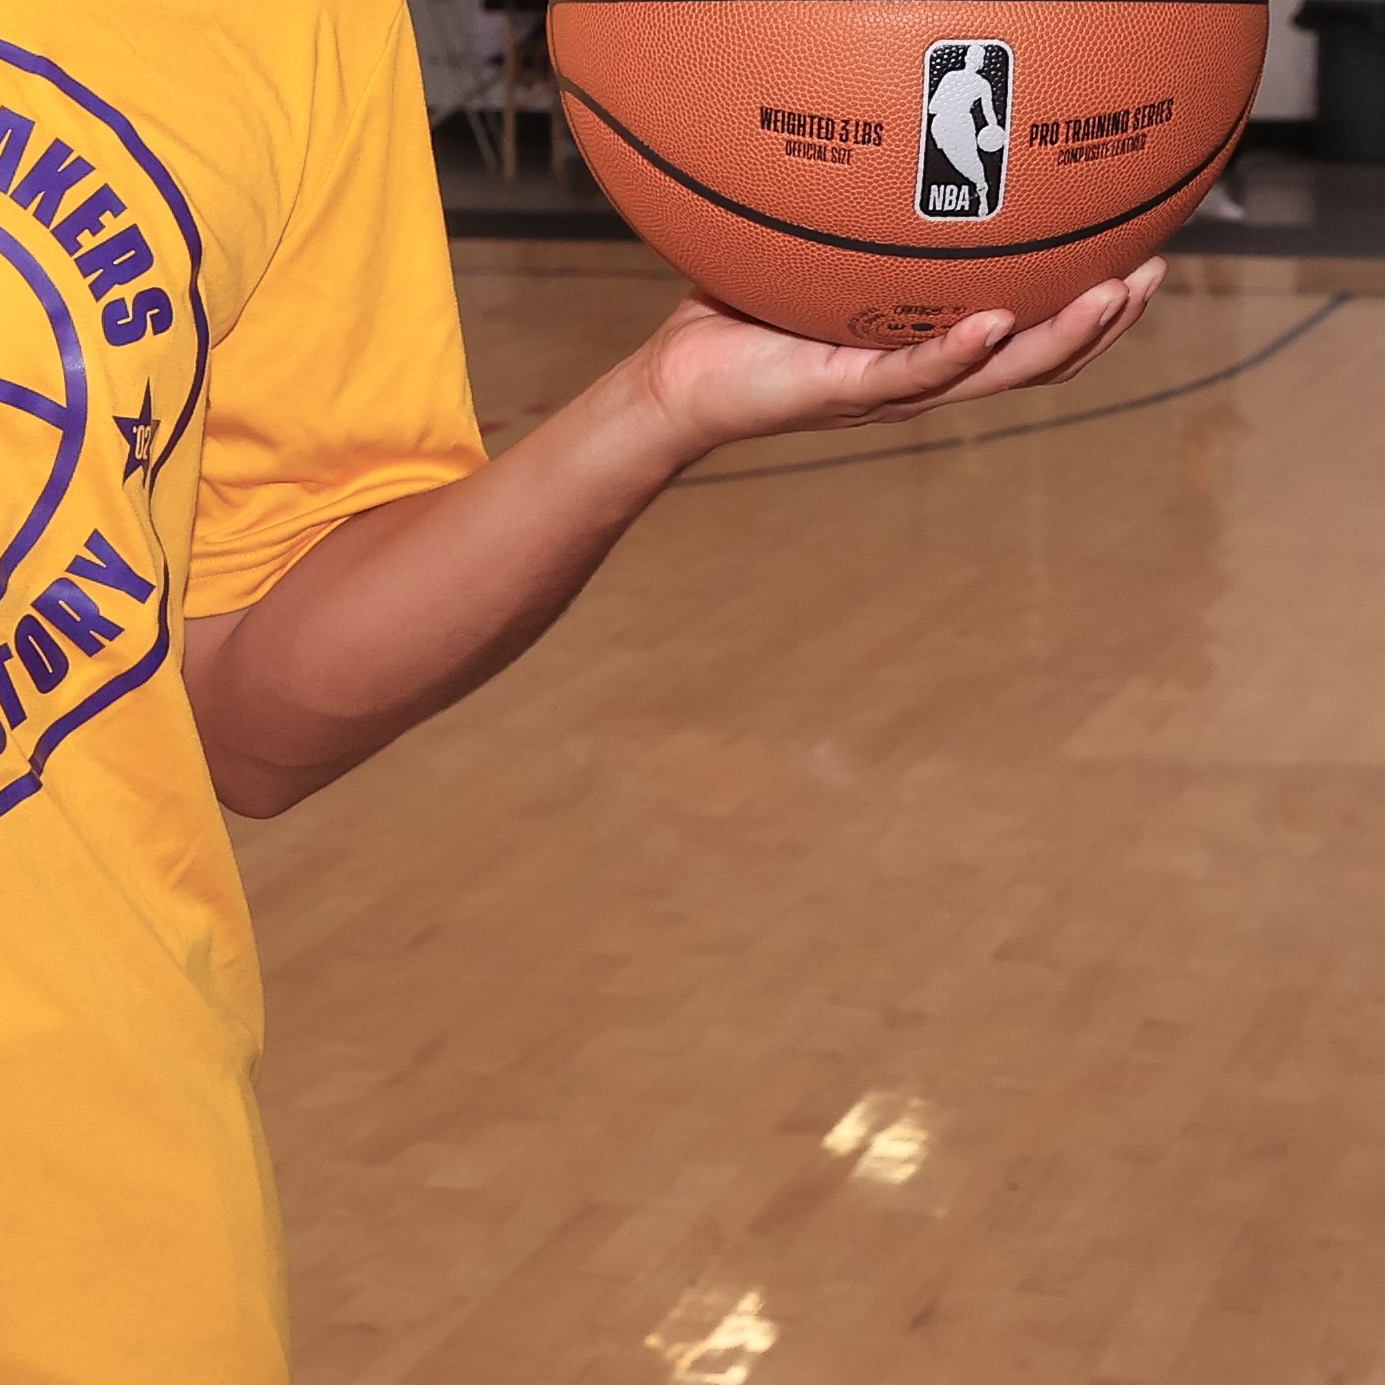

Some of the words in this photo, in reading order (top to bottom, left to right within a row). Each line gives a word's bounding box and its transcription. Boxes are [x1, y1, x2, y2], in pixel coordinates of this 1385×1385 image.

[759, 106, 835, 142] WEIGHTED
[853, 119, 885, 148] LBS
[1028, 122, 1061, 149] PRO
[1064, 109, 1131, 145] TRAINING
[1132, 97, 1175, 131] SERIES
[784, 140, 828, 163] OFFICIAL
[928, 184, 971, 212] NBA
